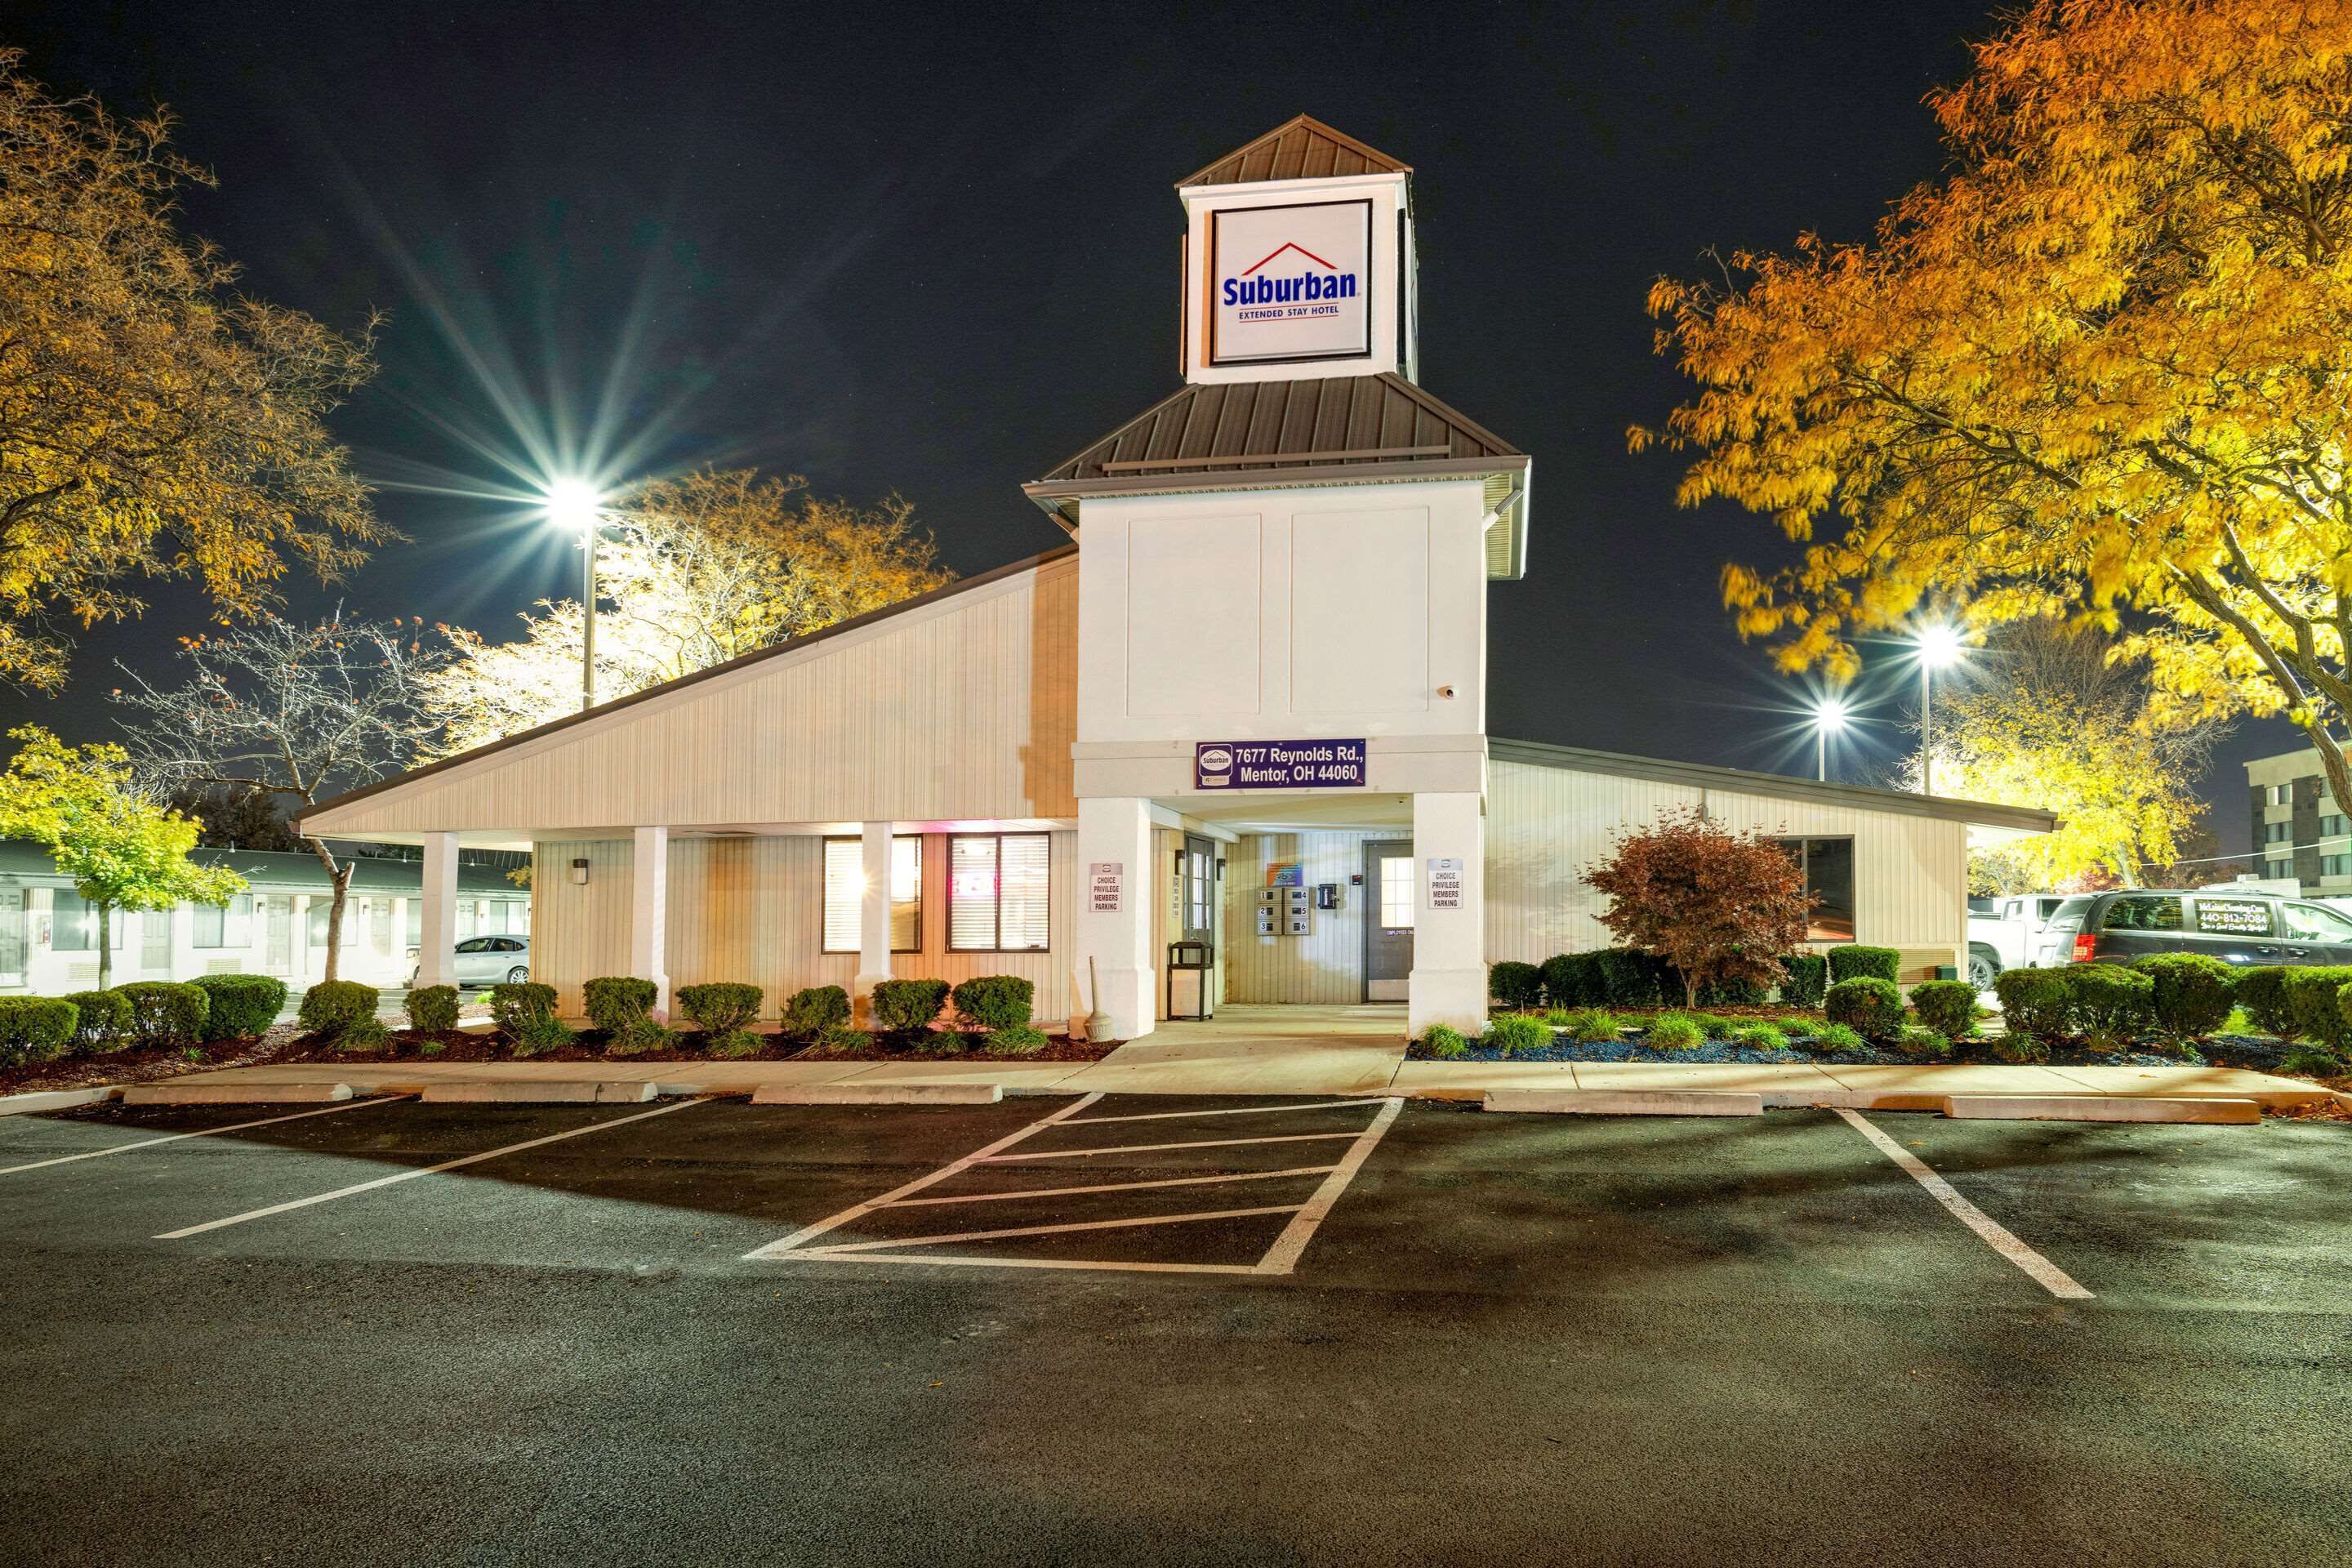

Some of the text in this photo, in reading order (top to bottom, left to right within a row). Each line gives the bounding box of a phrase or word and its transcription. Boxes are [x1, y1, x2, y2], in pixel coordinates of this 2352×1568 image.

[1223, 272, 1356, 305] Suburban
[1239, 306, 1339, 319] EXTENDED STAY HOTEL
[1236, 746, 1364, 765] 7677 Reynolds Rd.,
[1241, 764, 1357, 783] Mentor, OH 44060
[2200, 913, 2267, 924] 440-812-7084
